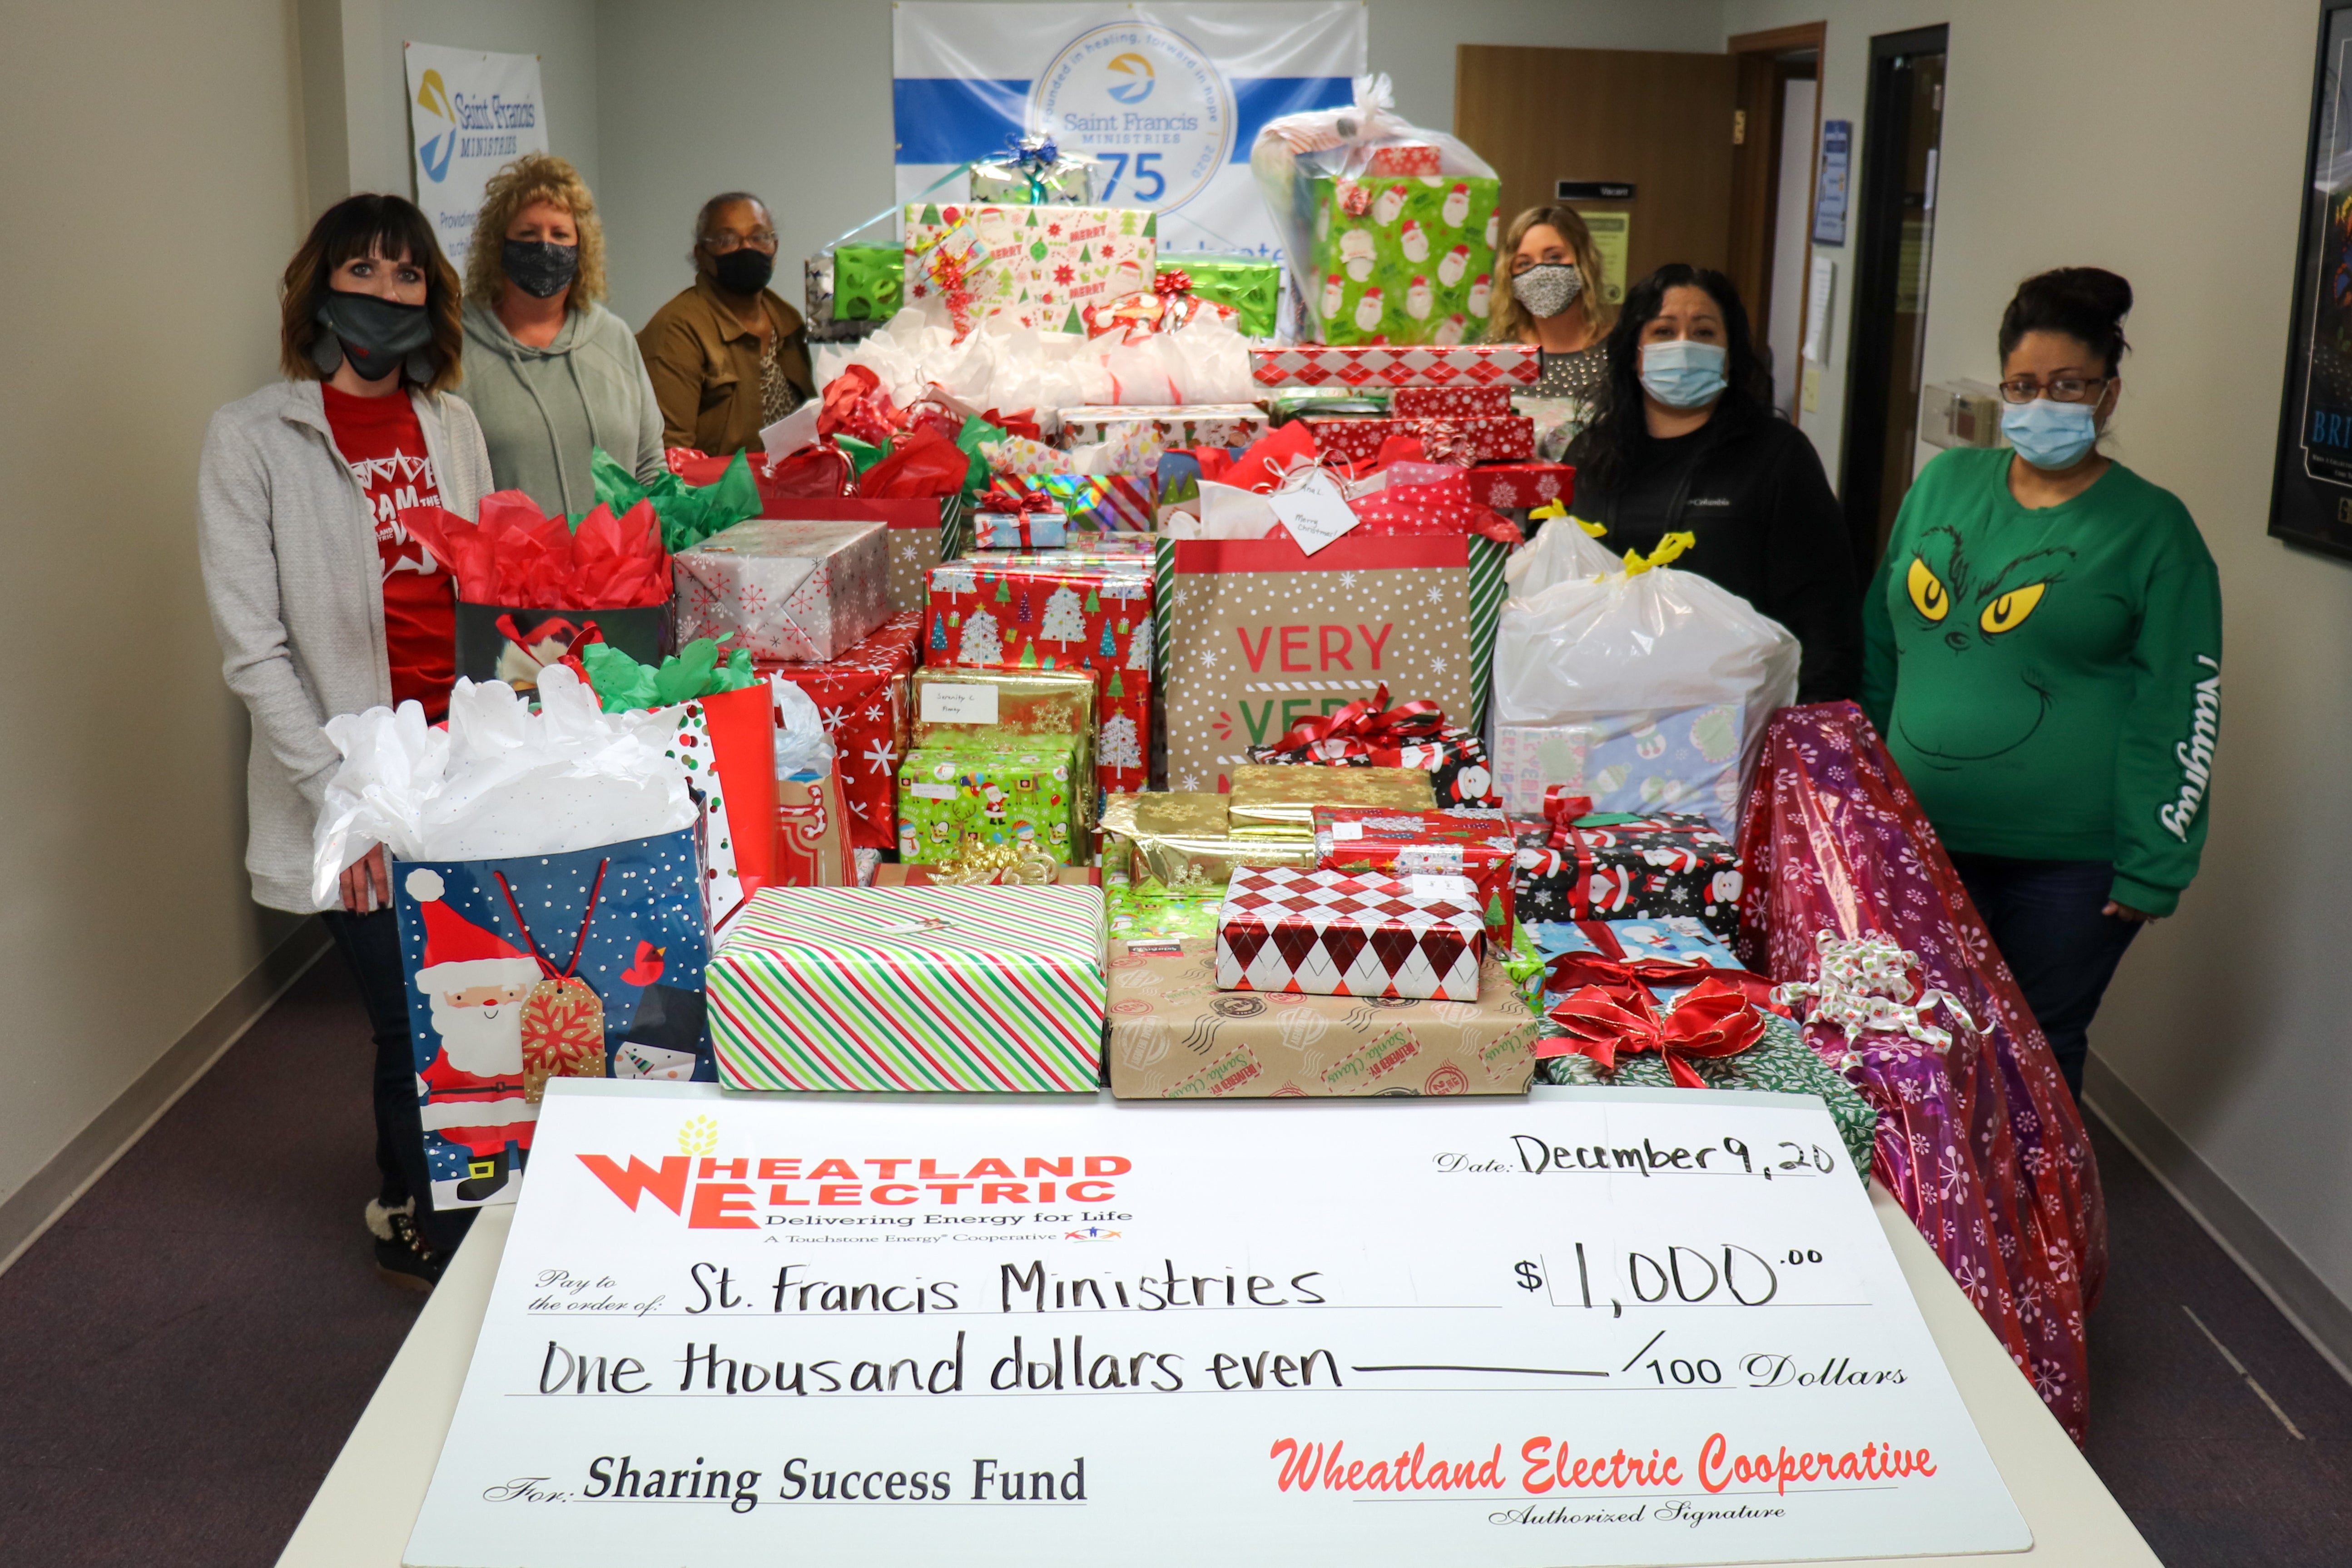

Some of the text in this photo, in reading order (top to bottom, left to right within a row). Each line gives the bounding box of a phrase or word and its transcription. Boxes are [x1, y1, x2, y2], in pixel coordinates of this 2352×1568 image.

[455, 93, 535, 130] Saint Francis
[1204, 85, 1218, 123] hope
[1064, 112, 1198, 131] Saint Francis
[460, 135, 517, 158] MINISTRIES
[1082, 134, 1181, 144] MINISTRIES
[1096, 153, 1166, 202] 75
[1191, 145, 1216, 179] 2020
[1600, 187, 1629, 196] Vacant
[1069, 225, 1107, 243] MERRY
[1069, 282, 1106, 299] MERRY
[420, 494, 441, 507] THE
[1295, 514, 1318, 529] Merry
[1236, 623, 1394, 673] VERY
[1327, 1031, 1406, 1084] Santa Claus
[1366, 1041, 1416, 1076] DELIVERED BY:
[1485, 1035, 1522, 1062] Claus
[1206, 1053, 1248, 1081] Santa
[1206, 1063, 1257, 1095] DELIVERED BY:
[1432, 1151, 1513, 1173] Date:
[1509, 1134, 1717, 1177] December
[575, 1153, 1132, 1217] WHEATLAND
[687, 1181, 1116, 1229] ELECTRIC
[765, 1211, 1133, 1227] Delivering Energy for Life
[785, 1235, 879, 1243] Touchstone
[953, 1233, 1057, 1242] Cooperative
[535, 1268, 618, 1295] Pay to
[685, 1259, 1326, 1314] St. Francis Ministries
[1513, 1260, 1543, 1292] $
[528, 1295, 666, 1318] the order of:
[673, 1330, 966, 1396] thousand
[990, 1334, 1185, 1392] dollars
[1205, 1349, 1343, 1389] even
[1738, 1353, 1907, 1388] Dollars
[1270, 1432, 1937, 1497] Wheatland Electric Cooperative
[482, 1455, 1088, 1513] For: Sharing Success Fund
[1488, 1500, 1786, 1528] Authorized Signature
